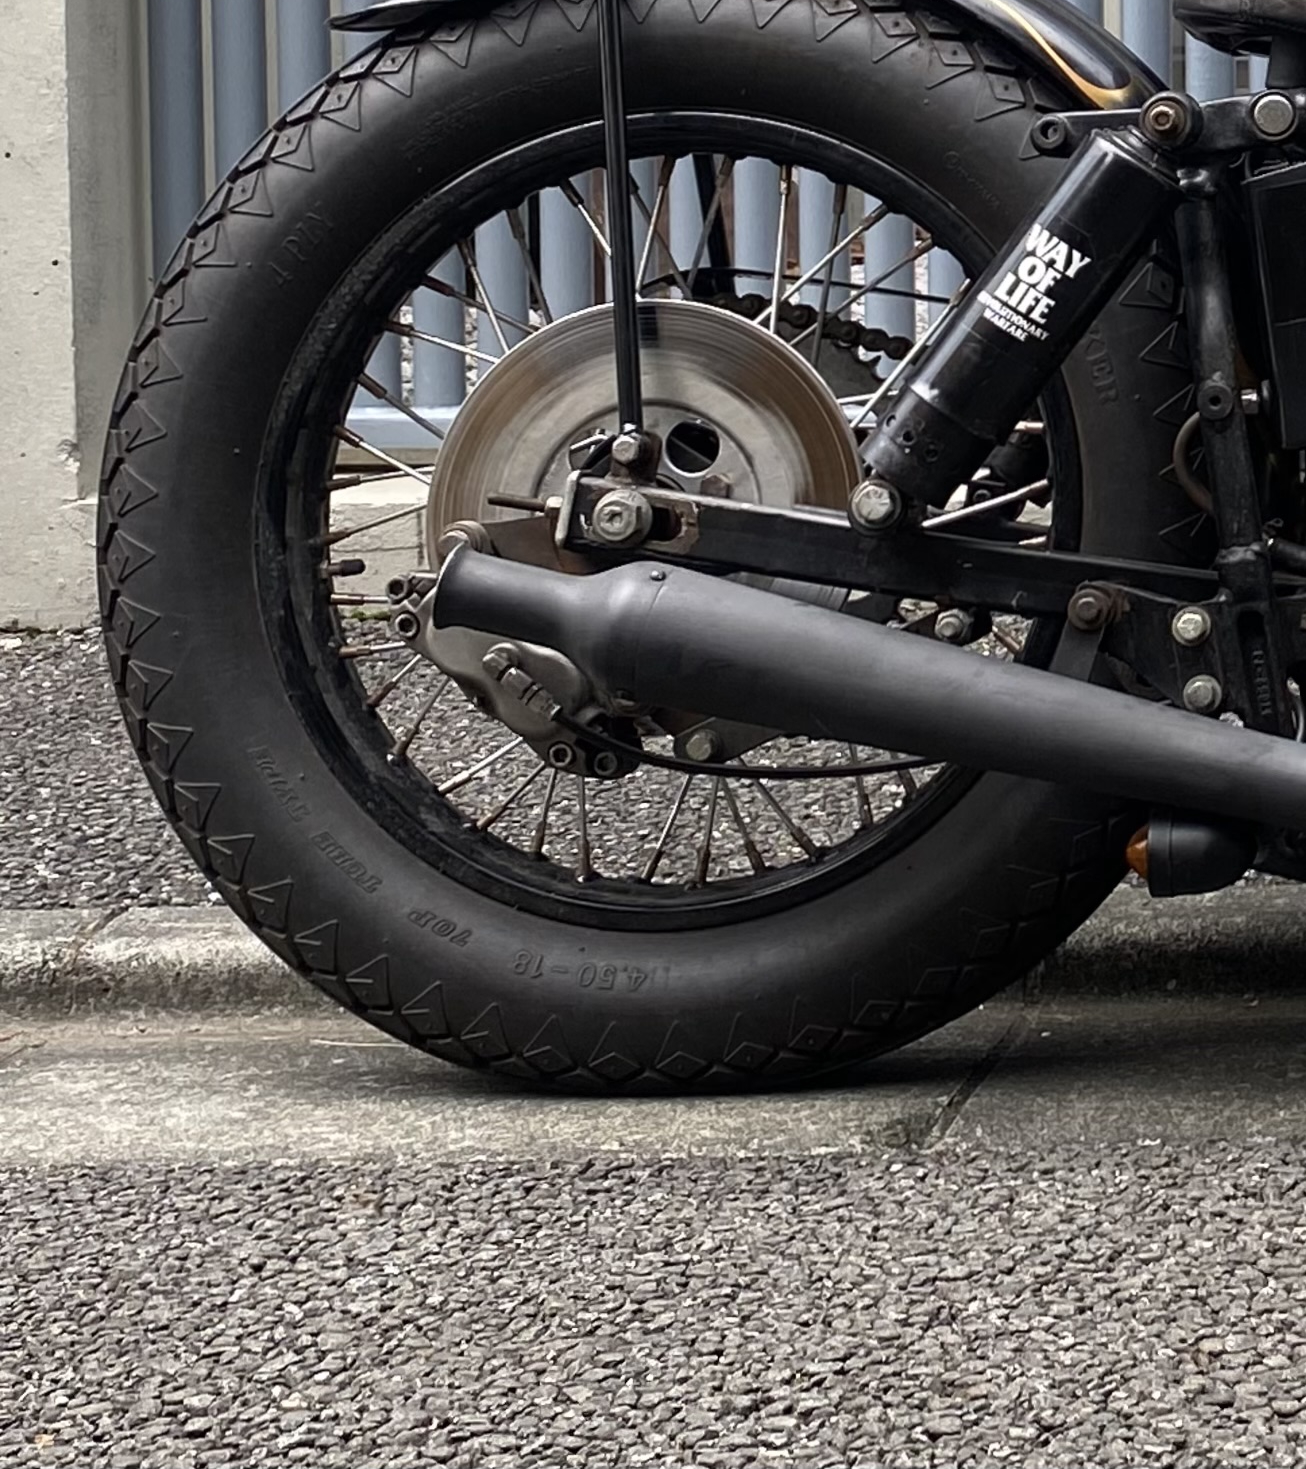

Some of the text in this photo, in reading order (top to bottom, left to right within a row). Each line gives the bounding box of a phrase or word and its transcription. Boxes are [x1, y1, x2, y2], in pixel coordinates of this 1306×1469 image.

[1017, 254, 1061, 293] OF
[1024, 223, 1092, 279] WAY
[993, 271, 1056, 325] LIFE
[310, 830, 384, 894] TUBE
